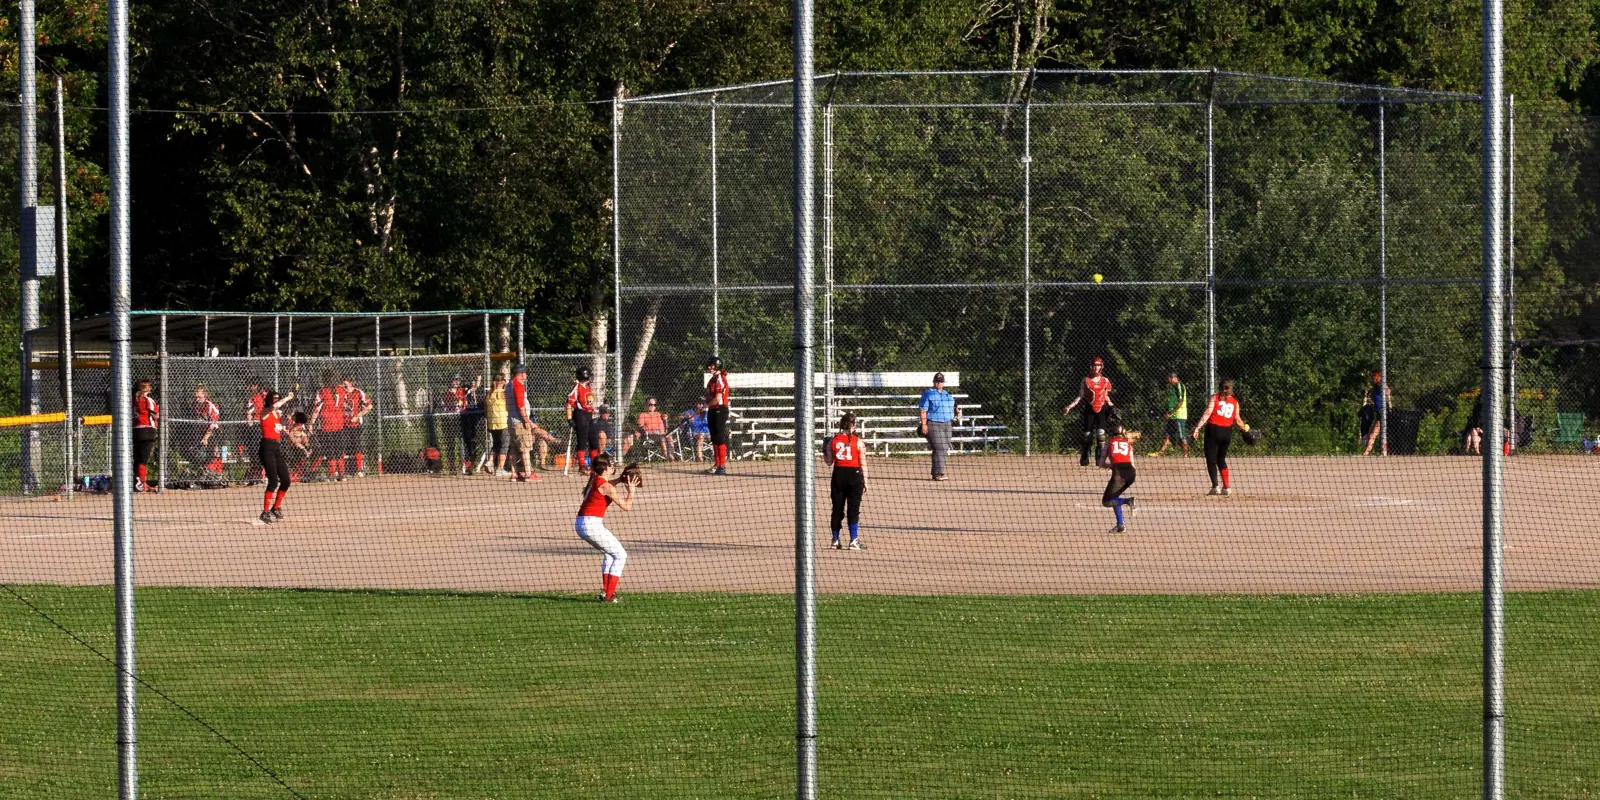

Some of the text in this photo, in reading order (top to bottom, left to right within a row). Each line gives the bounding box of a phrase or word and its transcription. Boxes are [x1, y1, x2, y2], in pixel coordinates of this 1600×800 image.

[1217, 401, 1234, 418] 38
[835, 441, 853, 460] 21
[1112, 441, 1129, 456] 15
